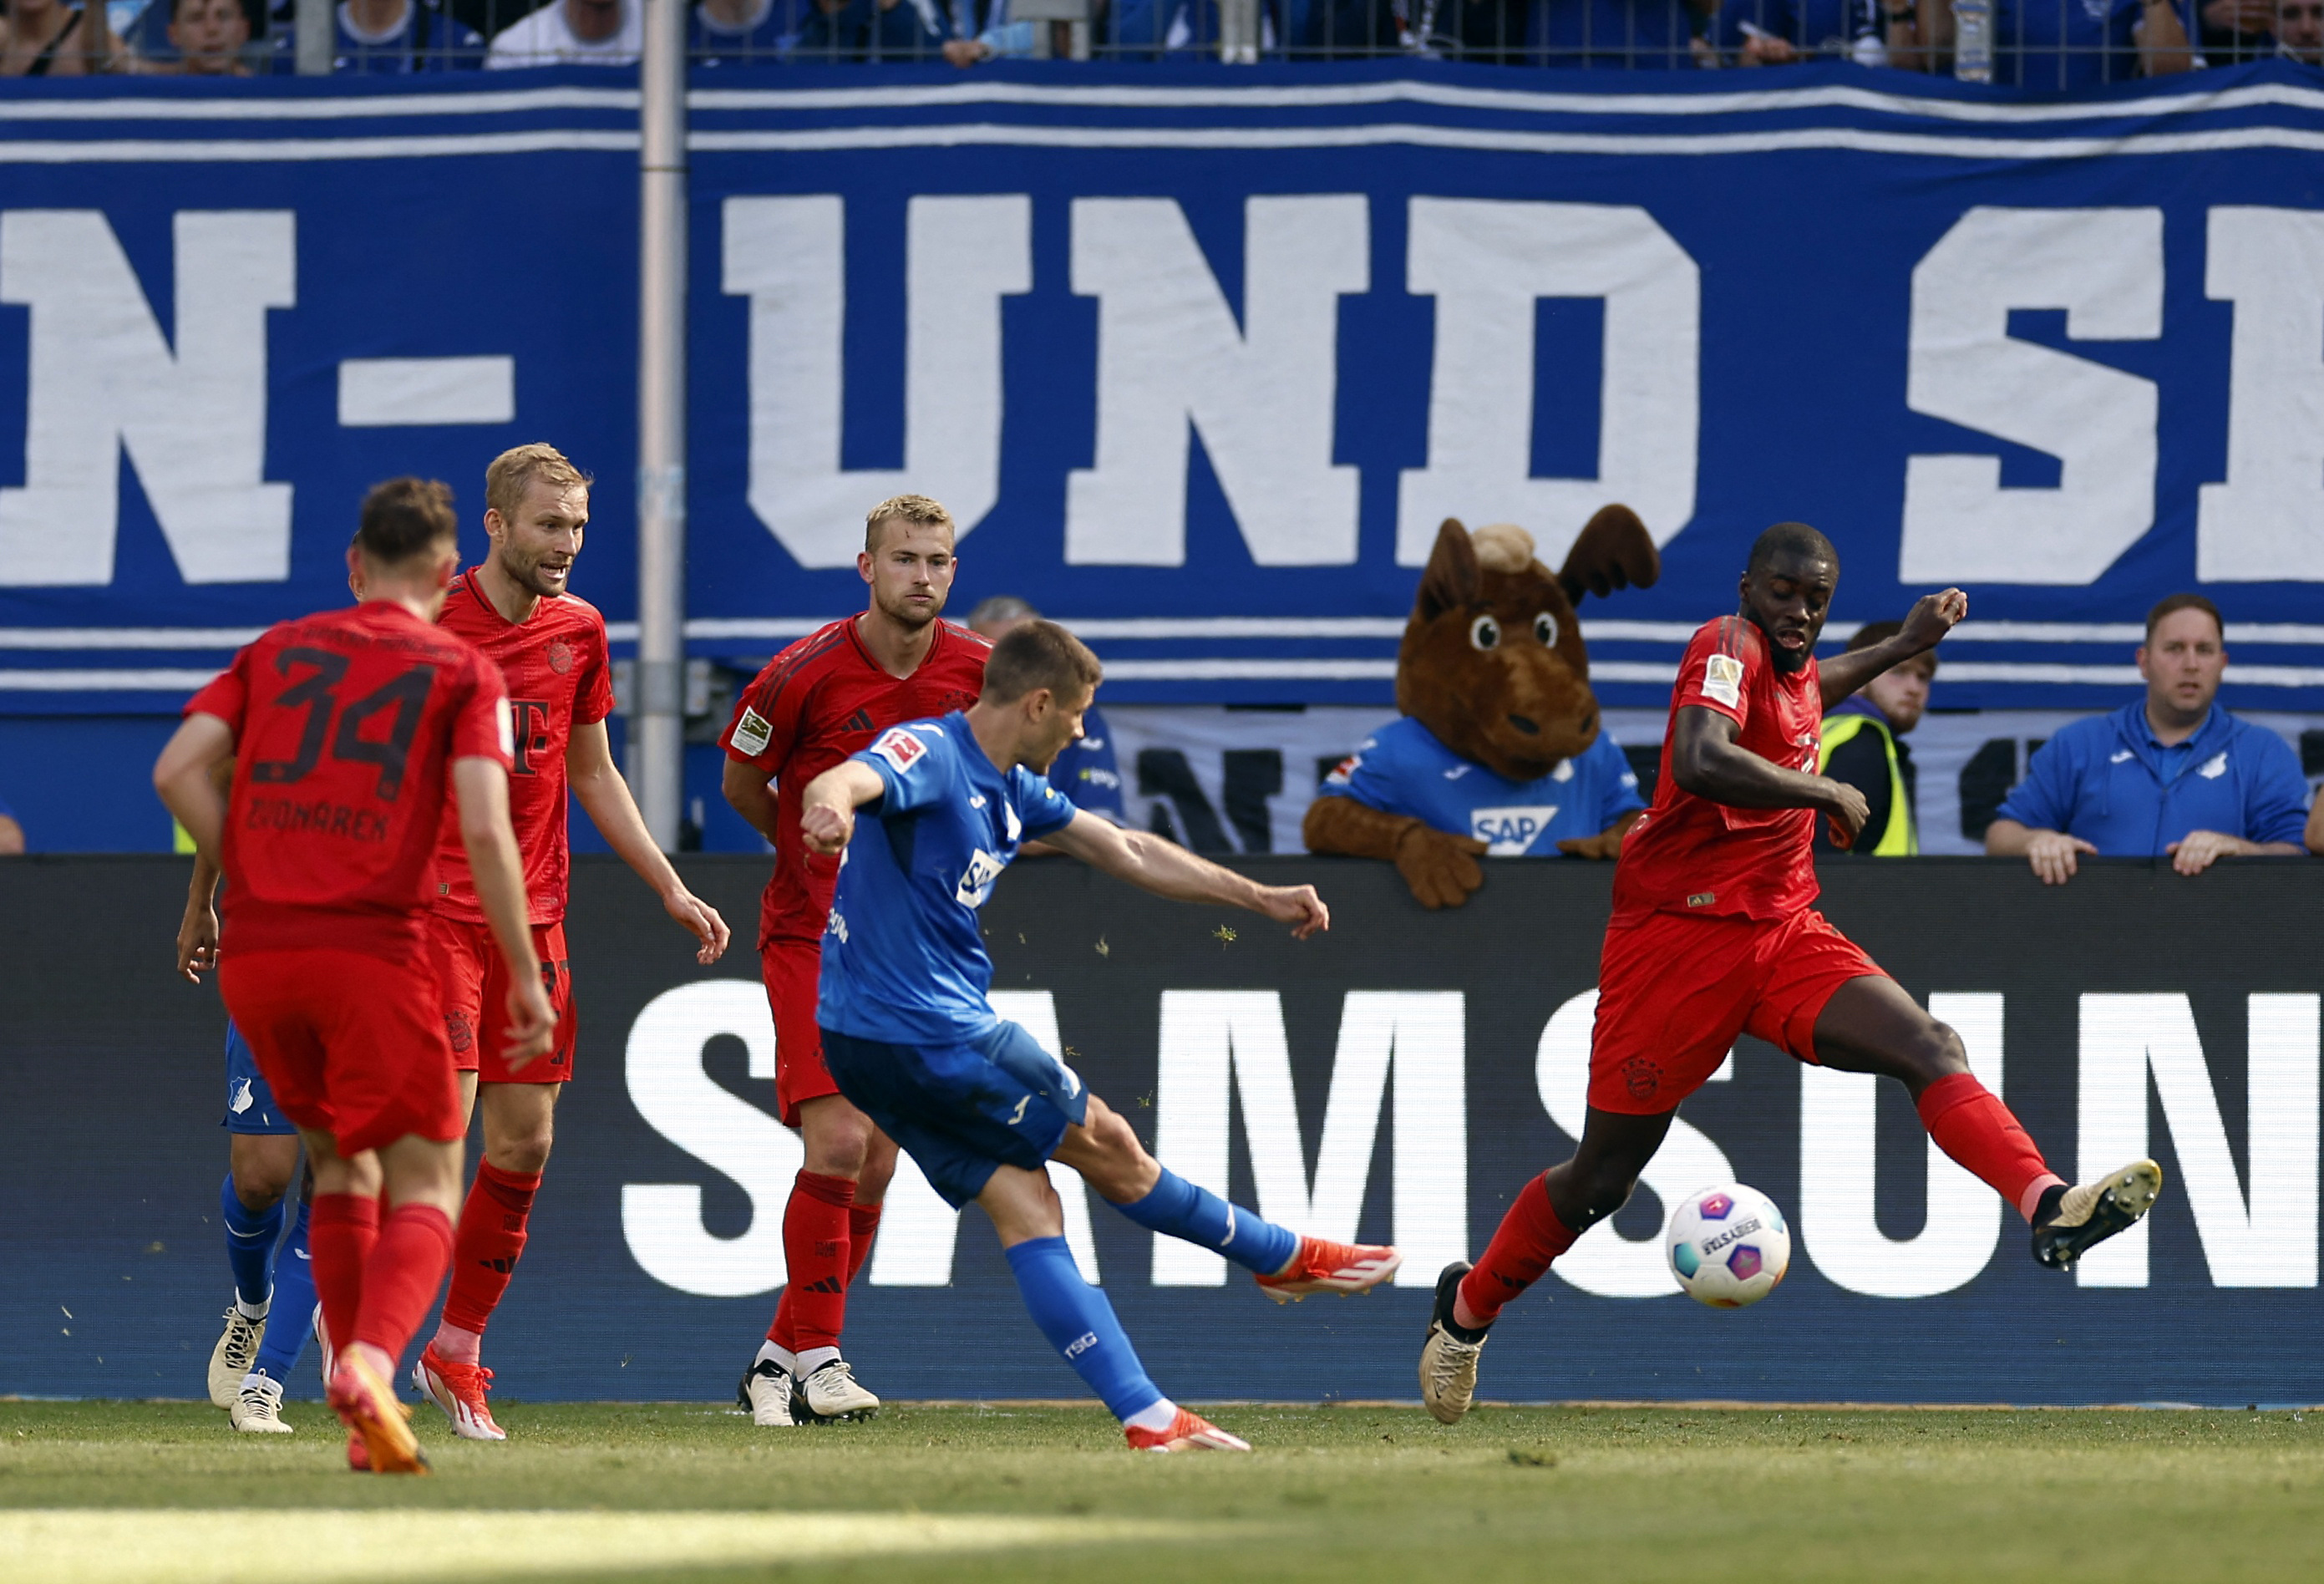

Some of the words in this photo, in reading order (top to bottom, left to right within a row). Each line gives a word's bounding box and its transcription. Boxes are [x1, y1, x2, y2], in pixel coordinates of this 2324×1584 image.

[720, 194, 1700, 569] UND
[251, 647, 439, 801] 34
[1477, 817, 1535, 844] SAP
[1064, 1331, 1098, 1360] TSG
